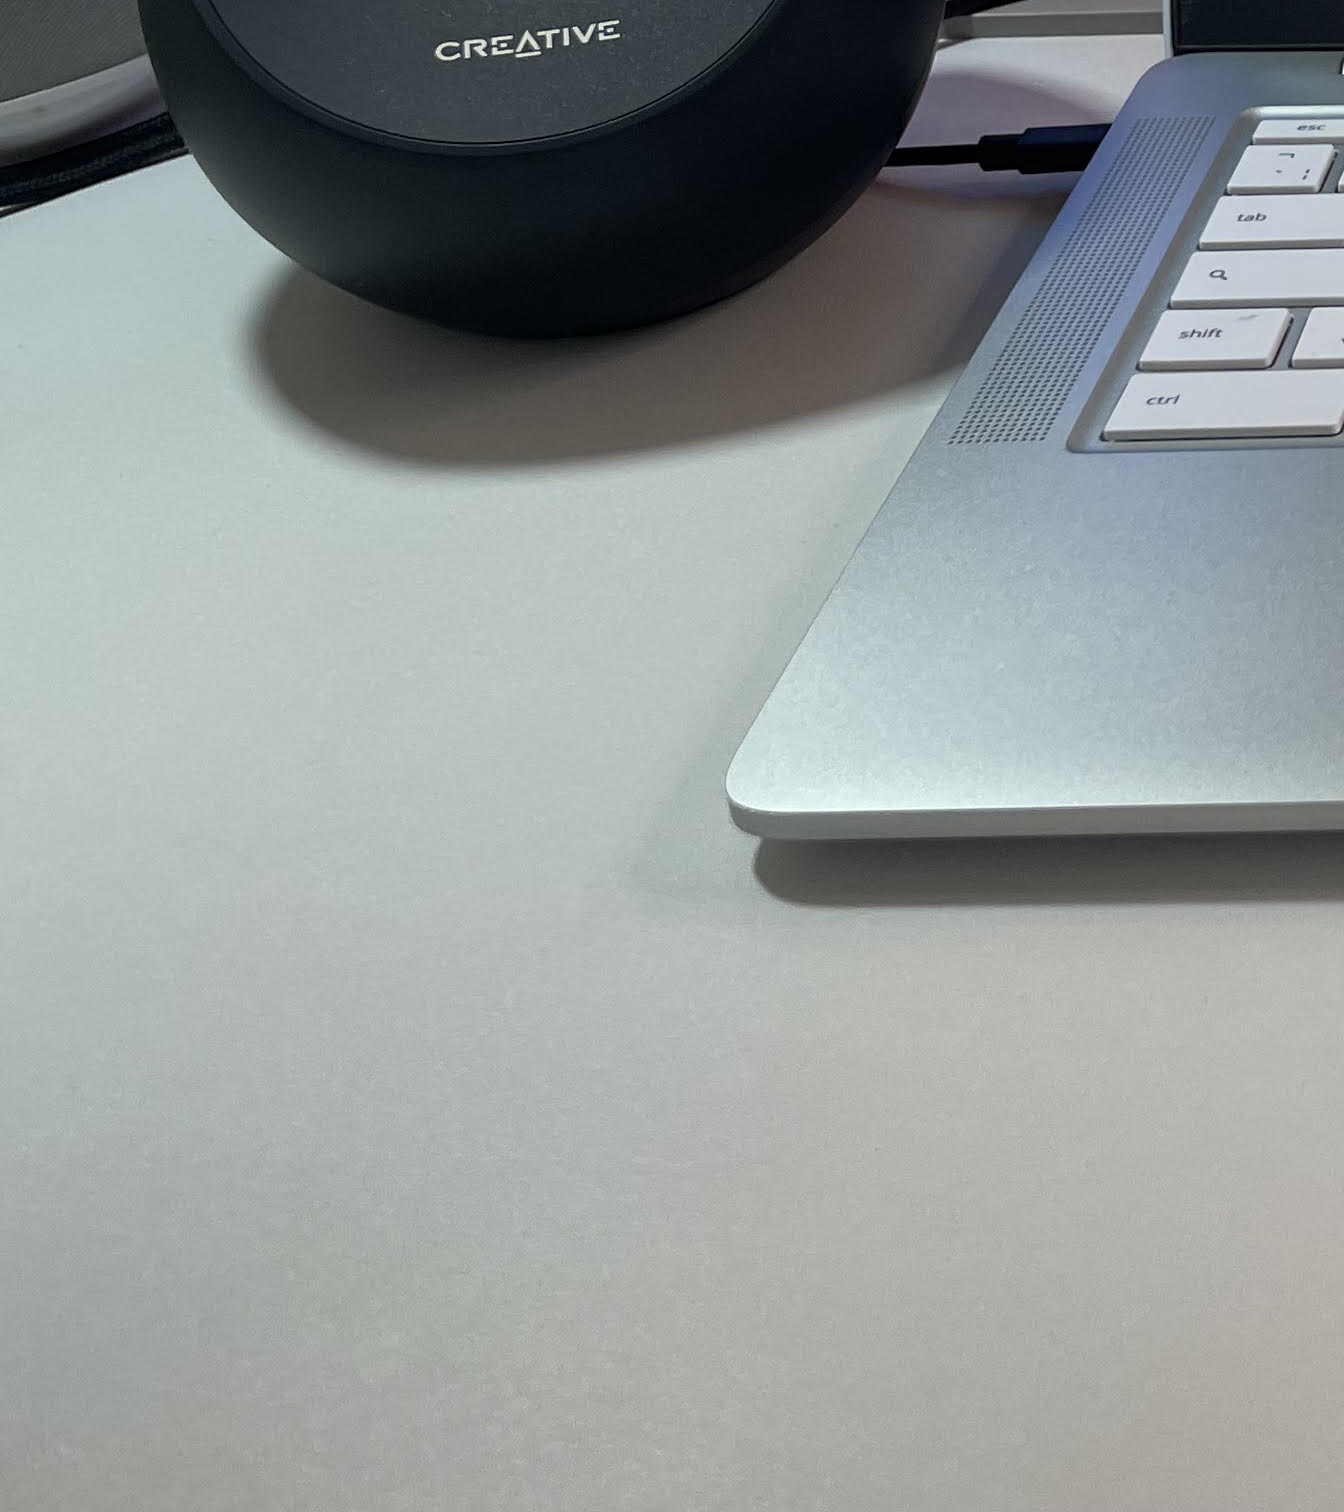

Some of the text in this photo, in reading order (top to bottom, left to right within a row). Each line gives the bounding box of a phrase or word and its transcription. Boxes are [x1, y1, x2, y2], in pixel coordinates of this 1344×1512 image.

[435, 20, 620, 61] CREATIVE
[1297, 124, 1326, 132] esc
[1237, 212, 1267, 223] tab
[1178, 327, 1223, 341] shift
[1146, 394, 1180, 406] ctrl
